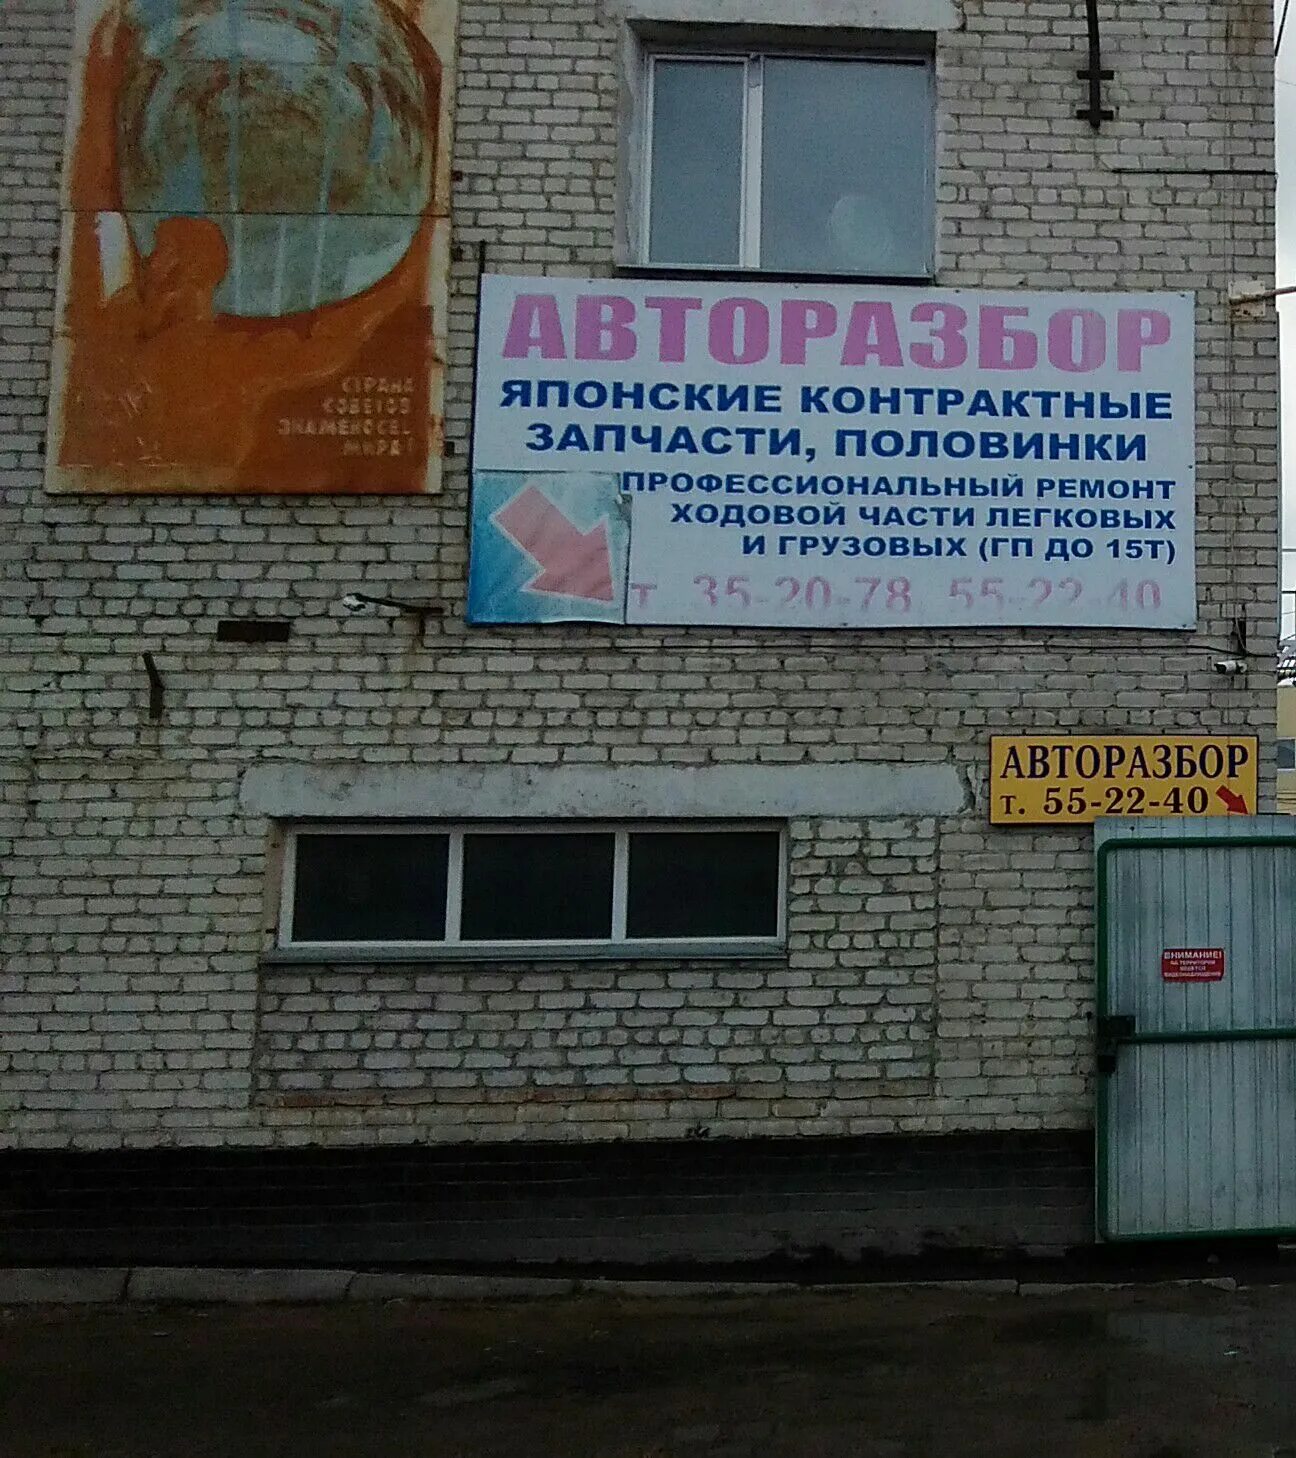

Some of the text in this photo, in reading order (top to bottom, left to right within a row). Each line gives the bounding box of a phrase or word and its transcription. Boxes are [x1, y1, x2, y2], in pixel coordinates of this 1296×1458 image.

[502, 293, 1172, 373] АВТОРАЗБОР
[500, 379, 1173, 420] ЯПОНСКИЕ КОНТРАКТНЫЕ
[526, 422, 1147, 463] ЗАПЧАСТИ, ПОЛОВИНКИ
[622, 471, 1176, 501] ПРОФЕССИОНАЛЬНЫЙ РЕМОНТ
[670, 501, 1176, 530] ХОДОВОЙ ЧАСТИ ЛЕГКОВЫХ
[742, 535, 765, 555] И
[778, 536, 967, 557] ГРУЗОВЫХ
[979, 537, 1033, 563] (ГП
[1044, 538, 1094, 563] ДО
[1000, 744, 1249, 779] АВТОРАЗБОР
[1043, 786, 1209, 815] 55-22-40
